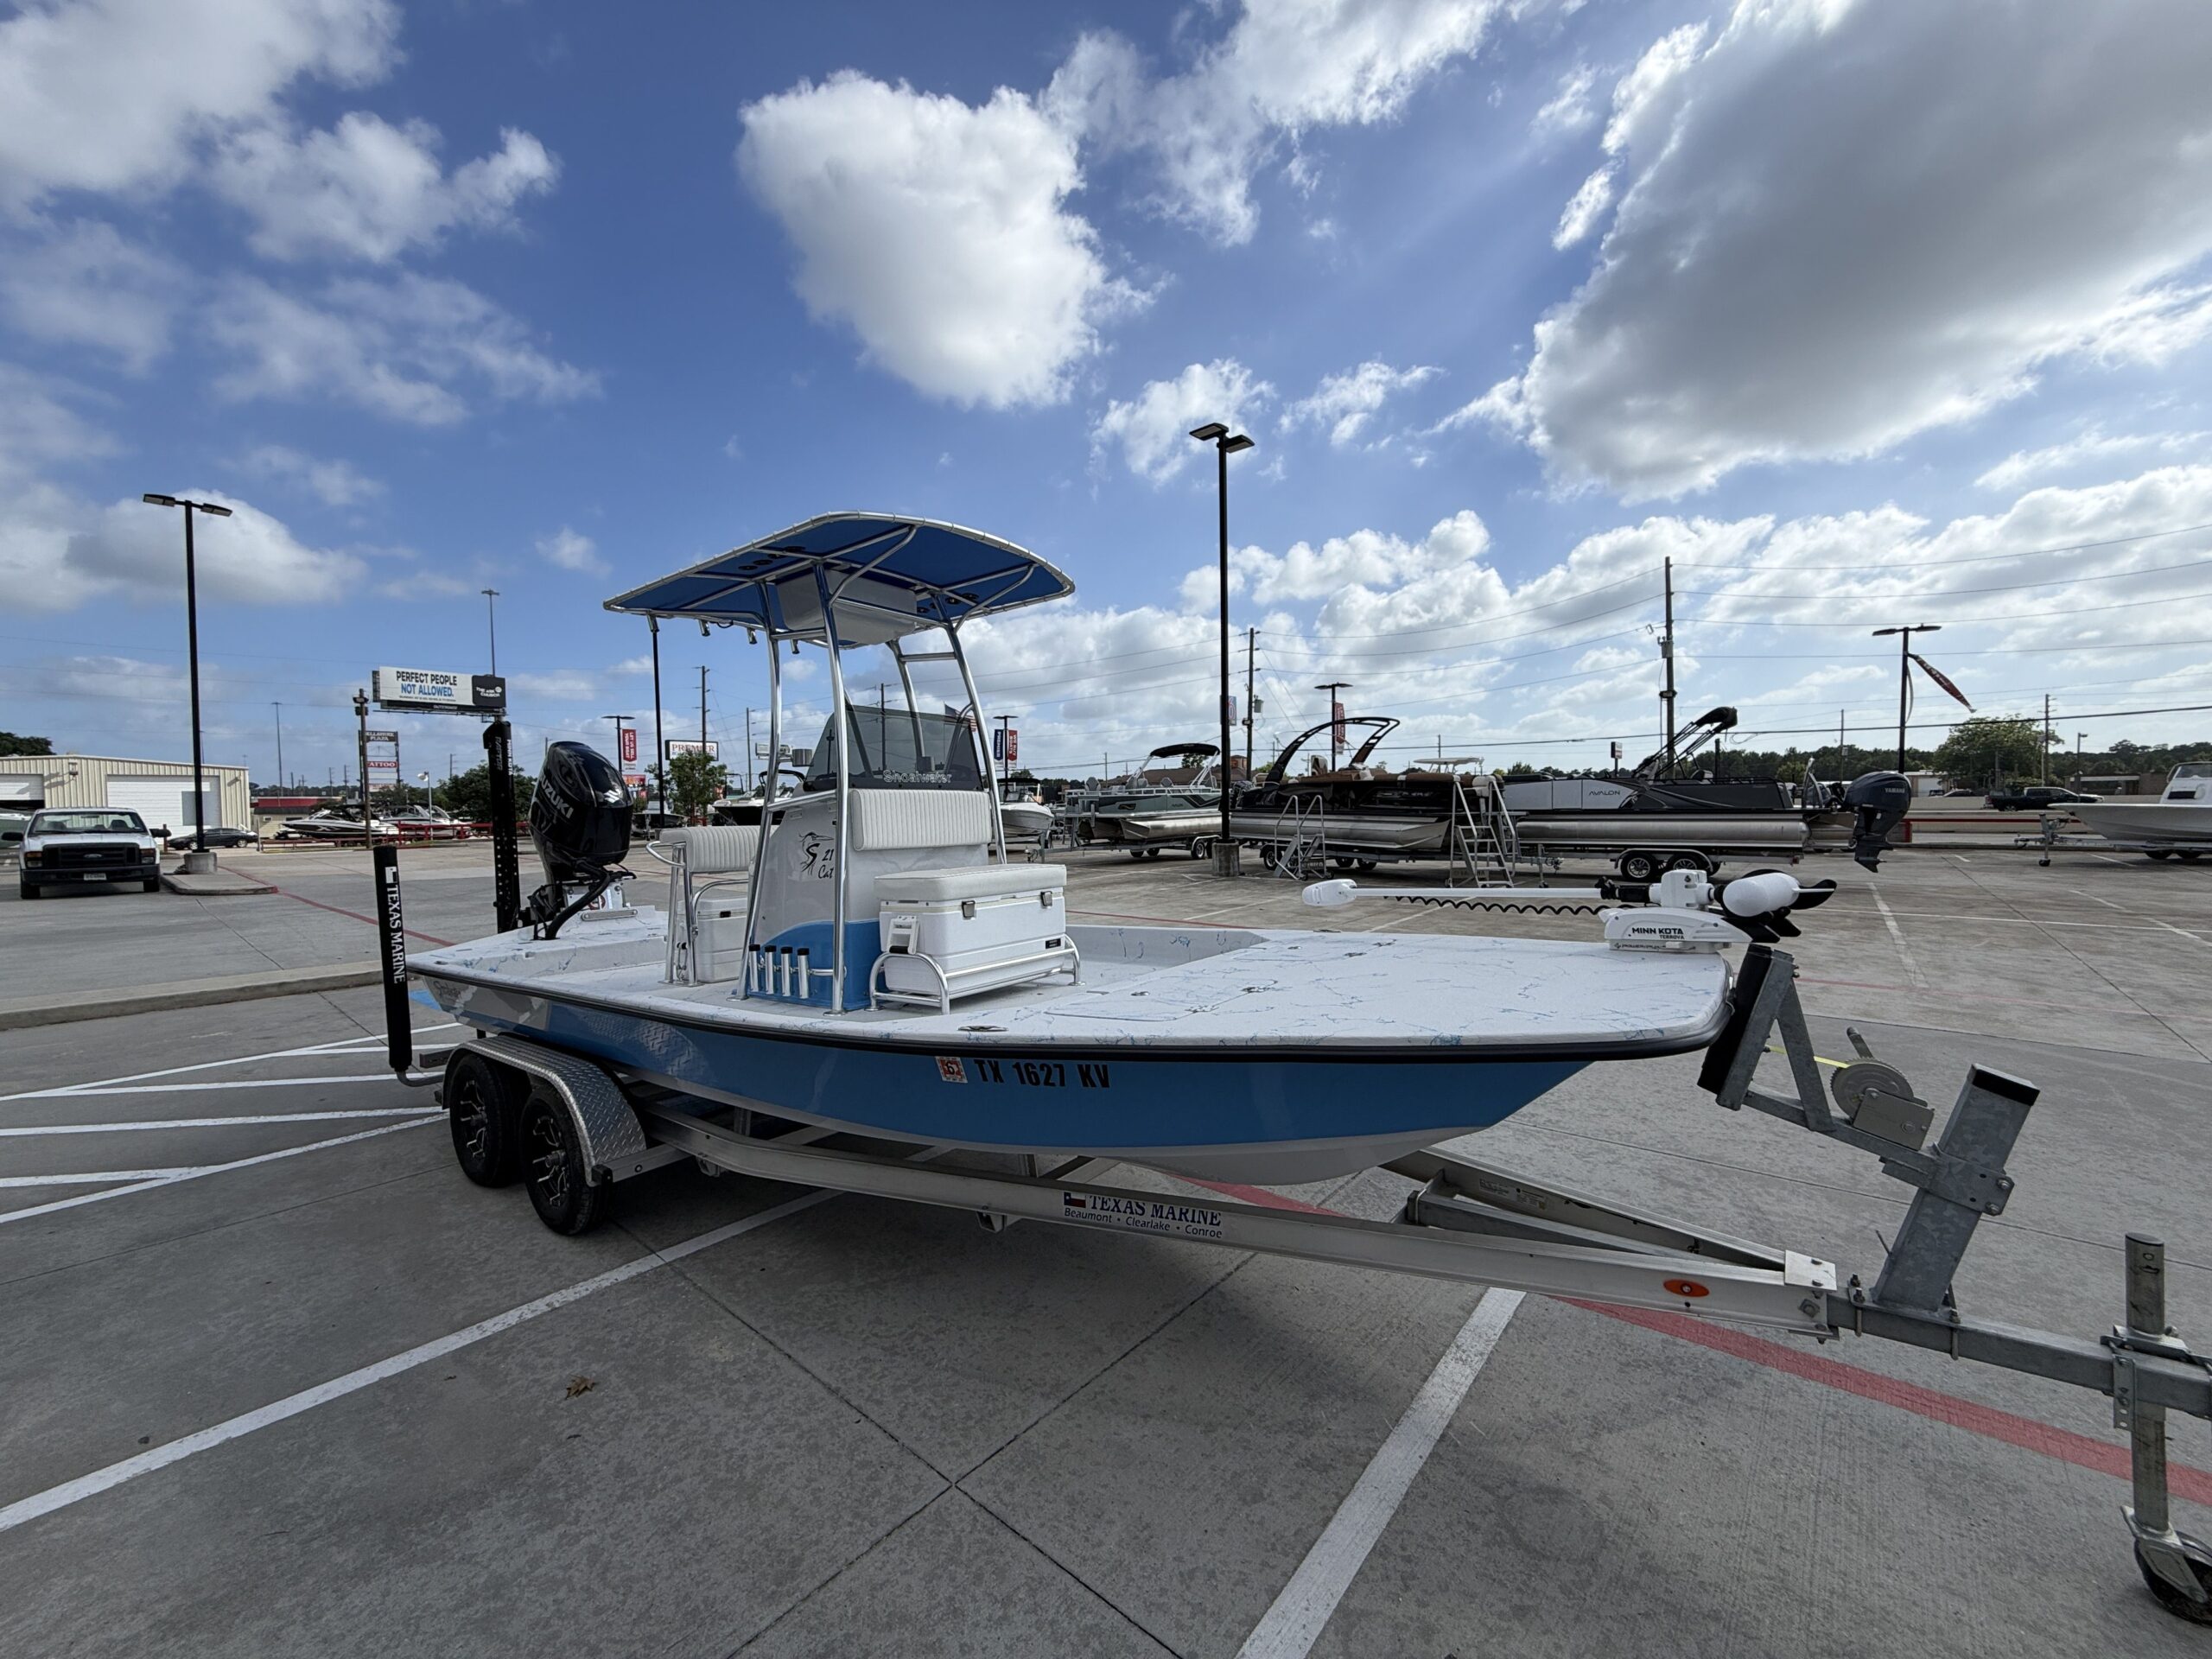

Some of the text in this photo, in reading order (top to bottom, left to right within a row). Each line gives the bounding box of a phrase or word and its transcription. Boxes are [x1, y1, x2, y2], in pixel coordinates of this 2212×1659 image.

[397, 671, 457, 686] PERFECT PEOPLE
[401, 683, 454, 697] NOT ALLOWED.
[671, 743, 715, 753] PREMIR
[882, 769, 952, 783] Shoalwater
[822, 849, 835, 861] 21
[817, 864, 835, 879] Cat
[386, 884, 406, 984] TEXAS MARINE
[973, 1059, 1110, 1088] TX 1627 KV
[1089, 1195, 1222, 1226] TEXAS MARINE
[1064, 1207, 1224, 1238] Beaumont Clearlake Conroe
